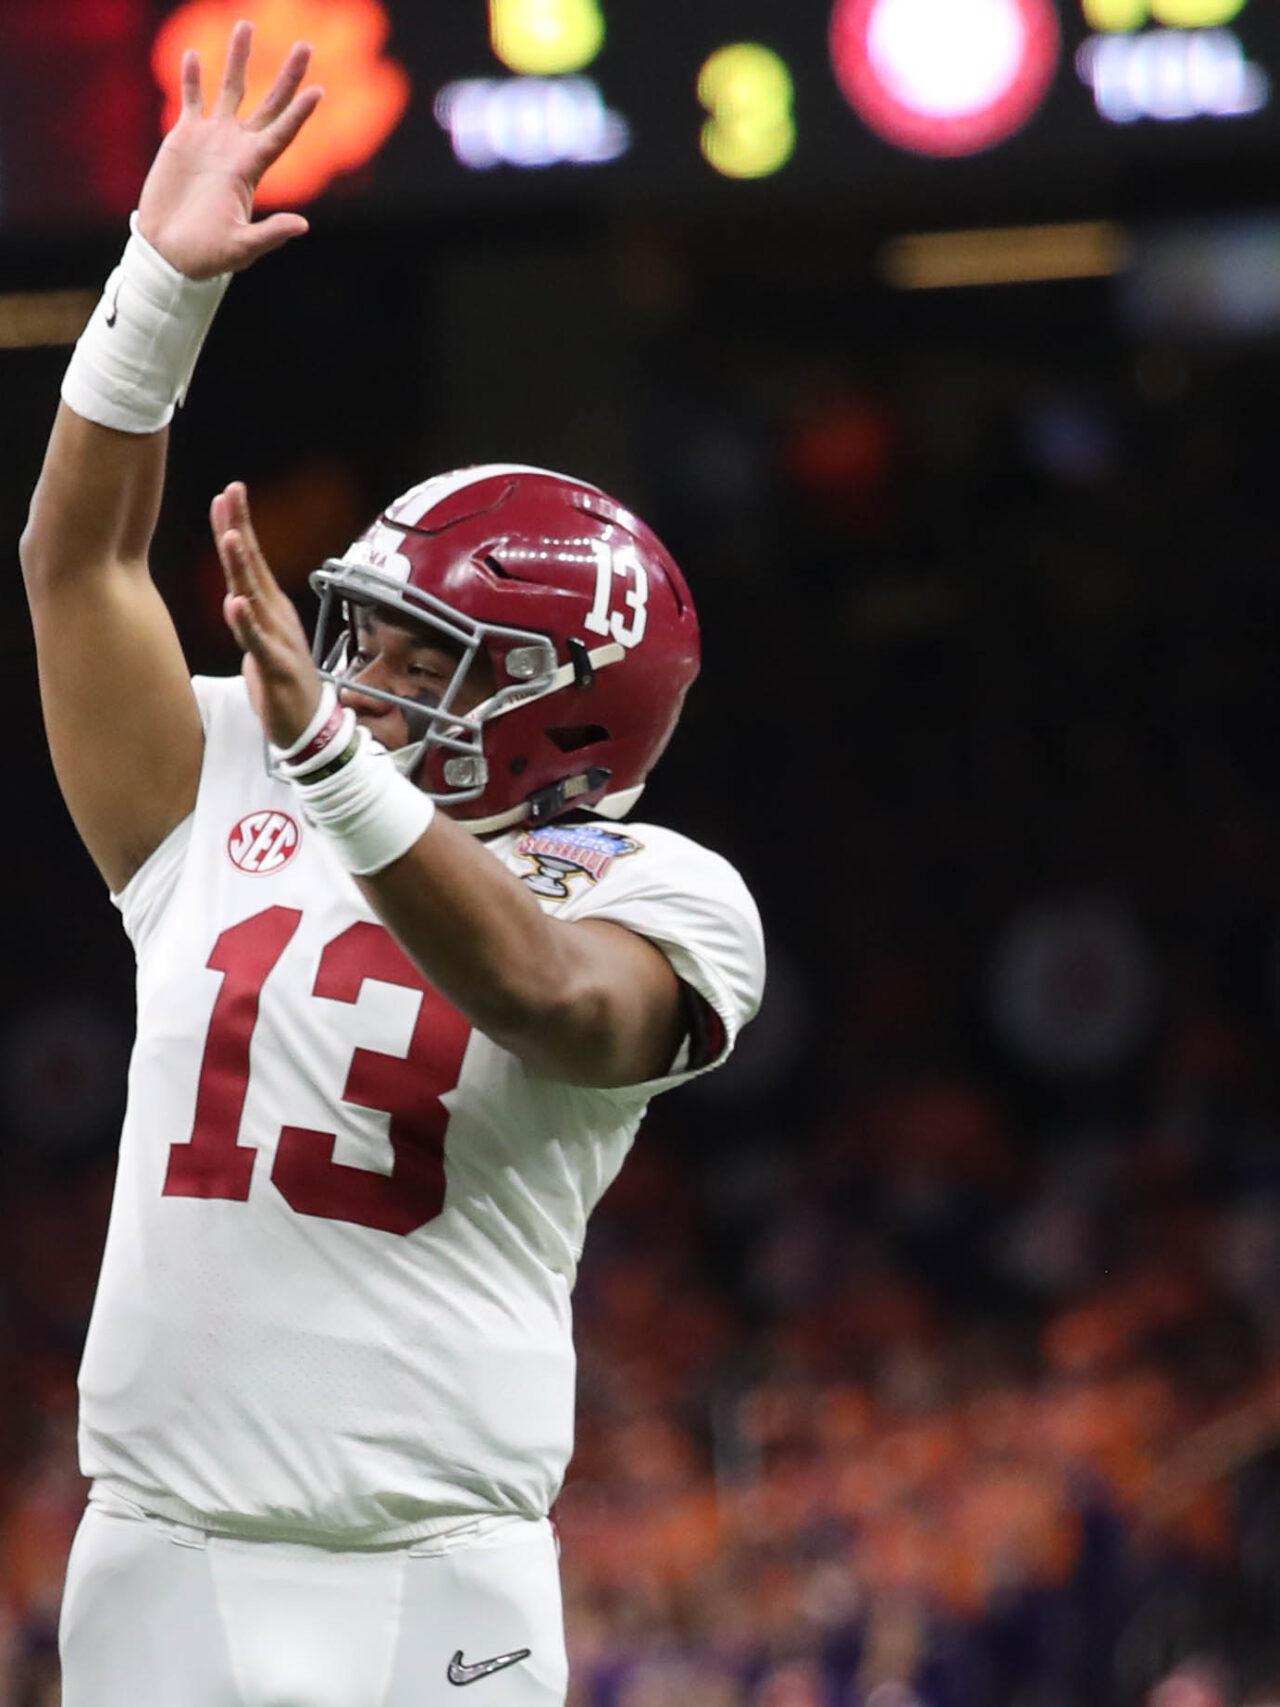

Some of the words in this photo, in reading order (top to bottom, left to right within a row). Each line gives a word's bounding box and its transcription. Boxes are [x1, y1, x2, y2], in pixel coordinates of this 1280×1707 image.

[584, 538, 649, 649] 13
[228, 810, 298, 872] SEC
[161, 905, 473, 1237] 13
